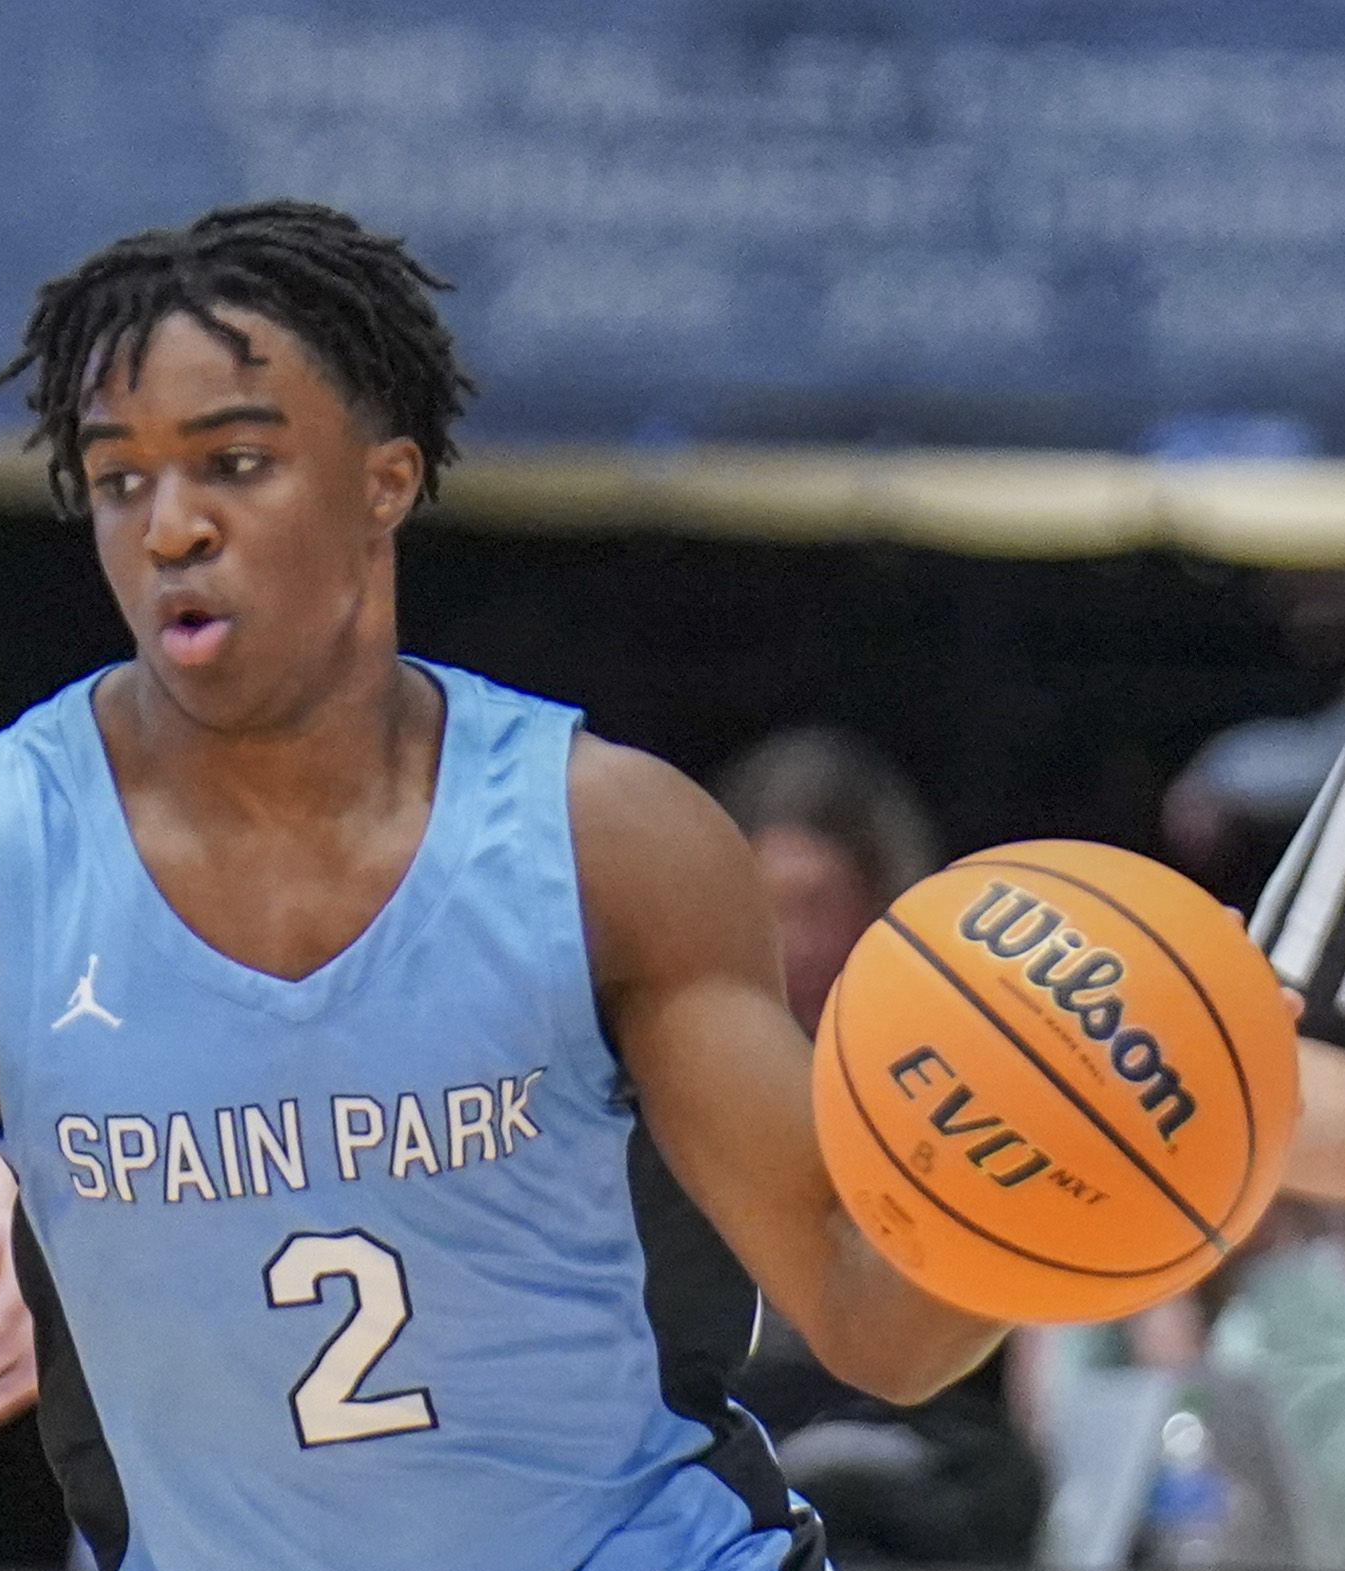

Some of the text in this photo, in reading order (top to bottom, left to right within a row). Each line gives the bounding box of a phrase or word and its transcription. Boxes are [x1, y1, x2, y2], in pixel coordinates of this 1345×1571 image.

[956, 880, 1197, 1142] Wilson
[55, 1066, 549, 1204] SPAIN PARK
[1049, 1171, 1111, 1206] NXT
[262, 1227, 440, 1450] 2
